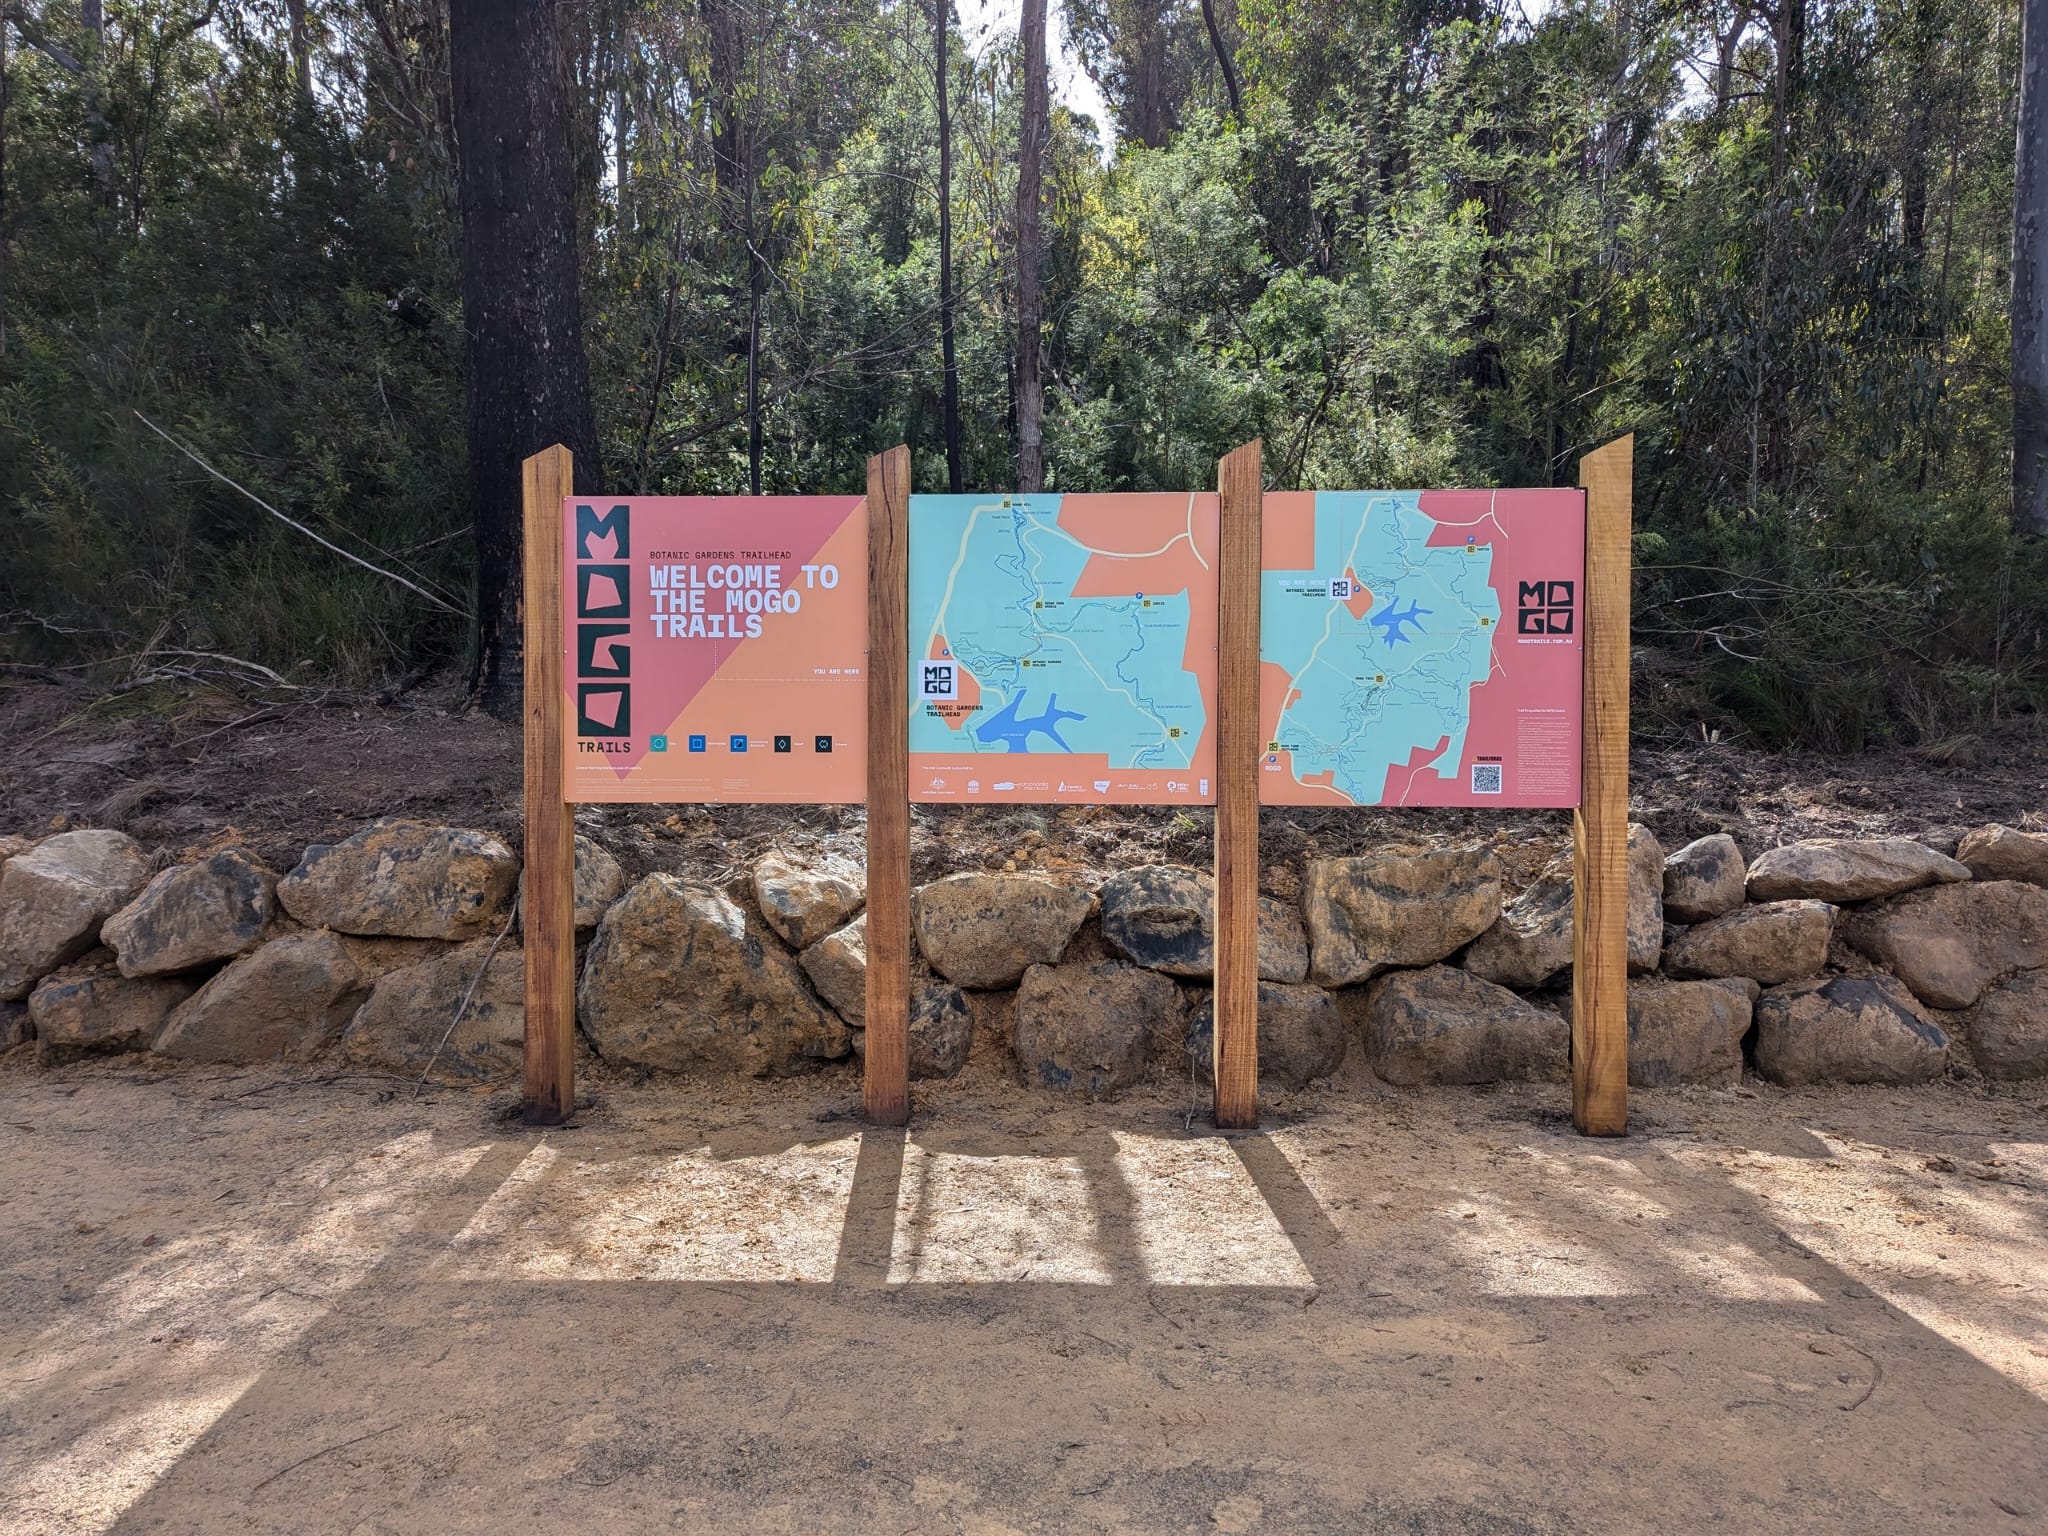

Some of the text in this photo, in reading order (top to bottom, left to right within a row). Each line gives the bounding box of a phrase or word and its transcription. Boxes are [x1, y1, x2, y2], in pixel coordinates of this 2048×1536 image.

[649, 551, 792, 560] BOTANIC GARDENS TRAILHEAD
[650, 565, 839, 589] WELCOME TO
[650, 590, 801, 613] THE MOGO
[650, 614, 763, 638] TRAILS
[577, 741, 632, 753] TRAILS
